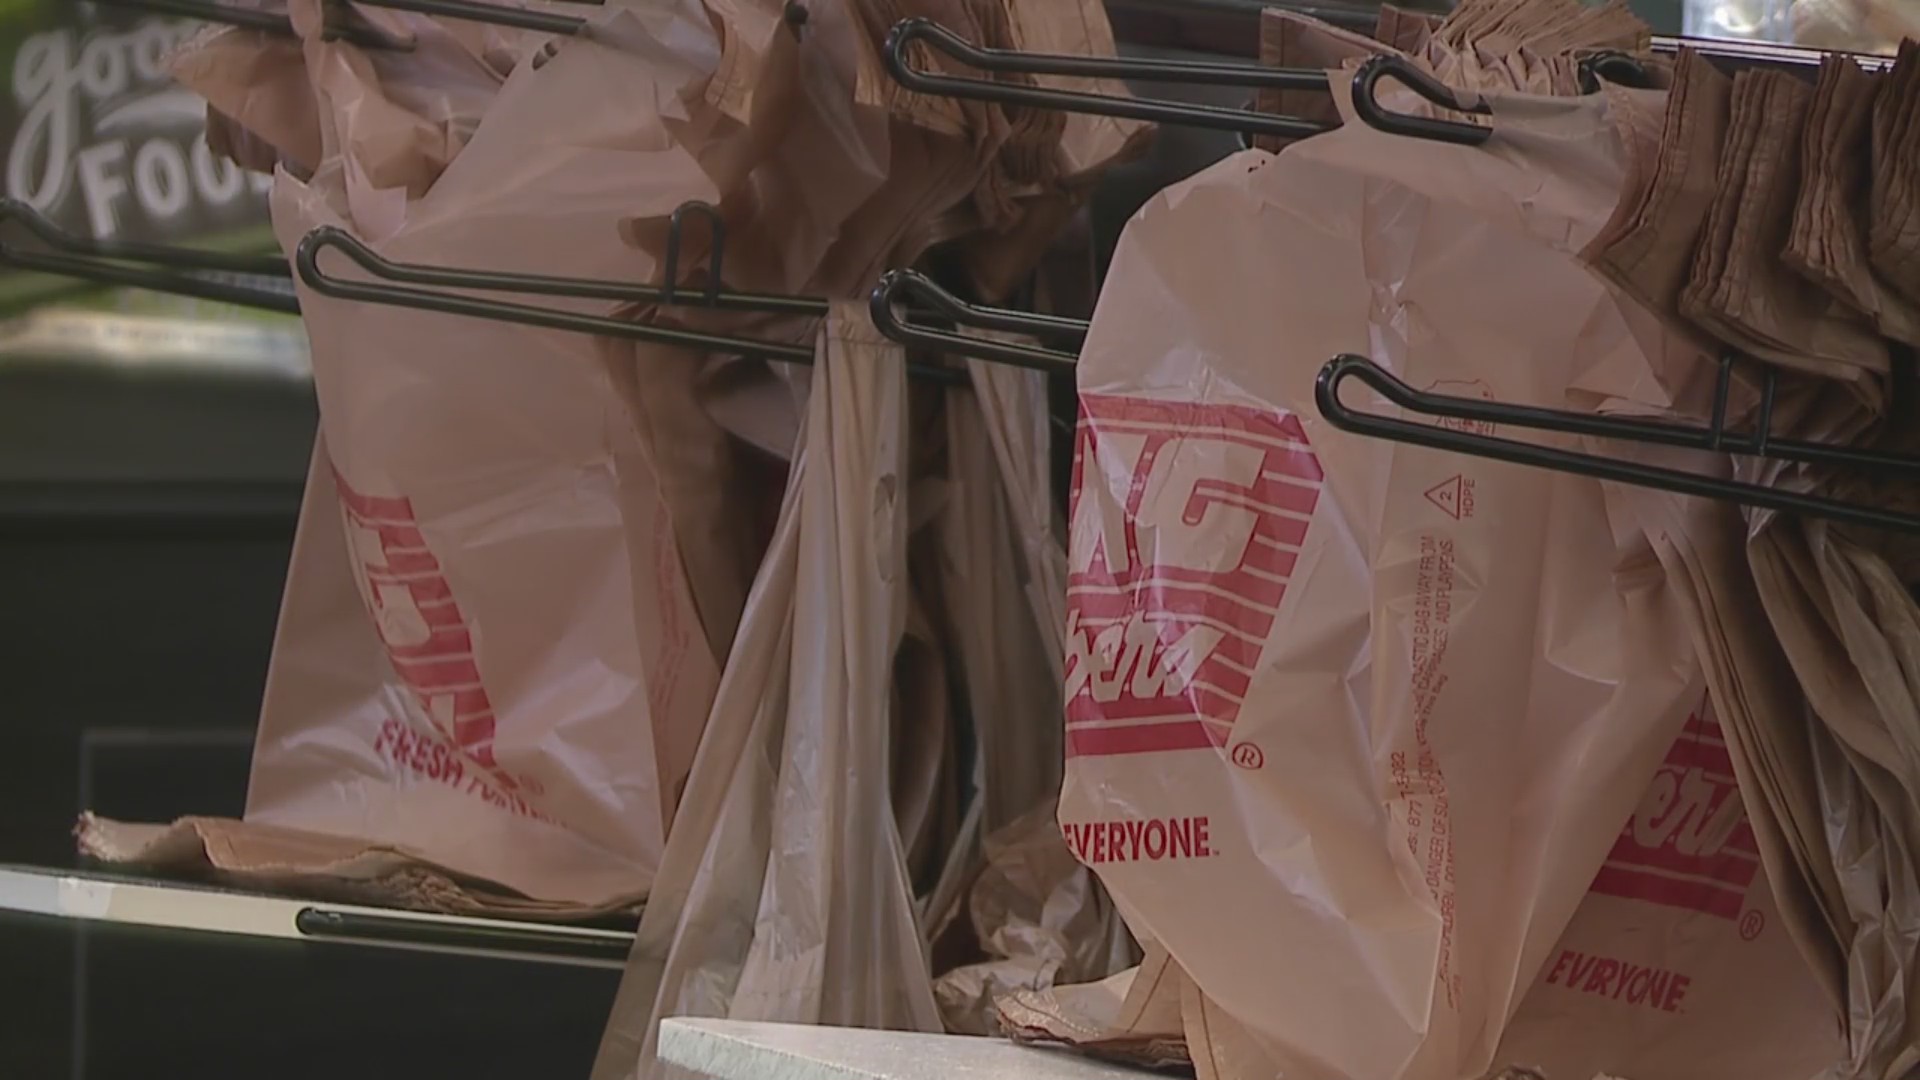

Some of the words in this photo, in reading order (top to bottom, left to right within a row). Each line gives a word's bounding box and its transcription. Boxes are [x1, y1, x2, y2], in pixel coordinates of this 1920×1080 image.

[78, 132, 276, 244] FOO
[1462, 478, 1476, 518] HDPE
[1414, 610, 1431, 635] BAG
[1426, 837, 1444, 889] DANGER
